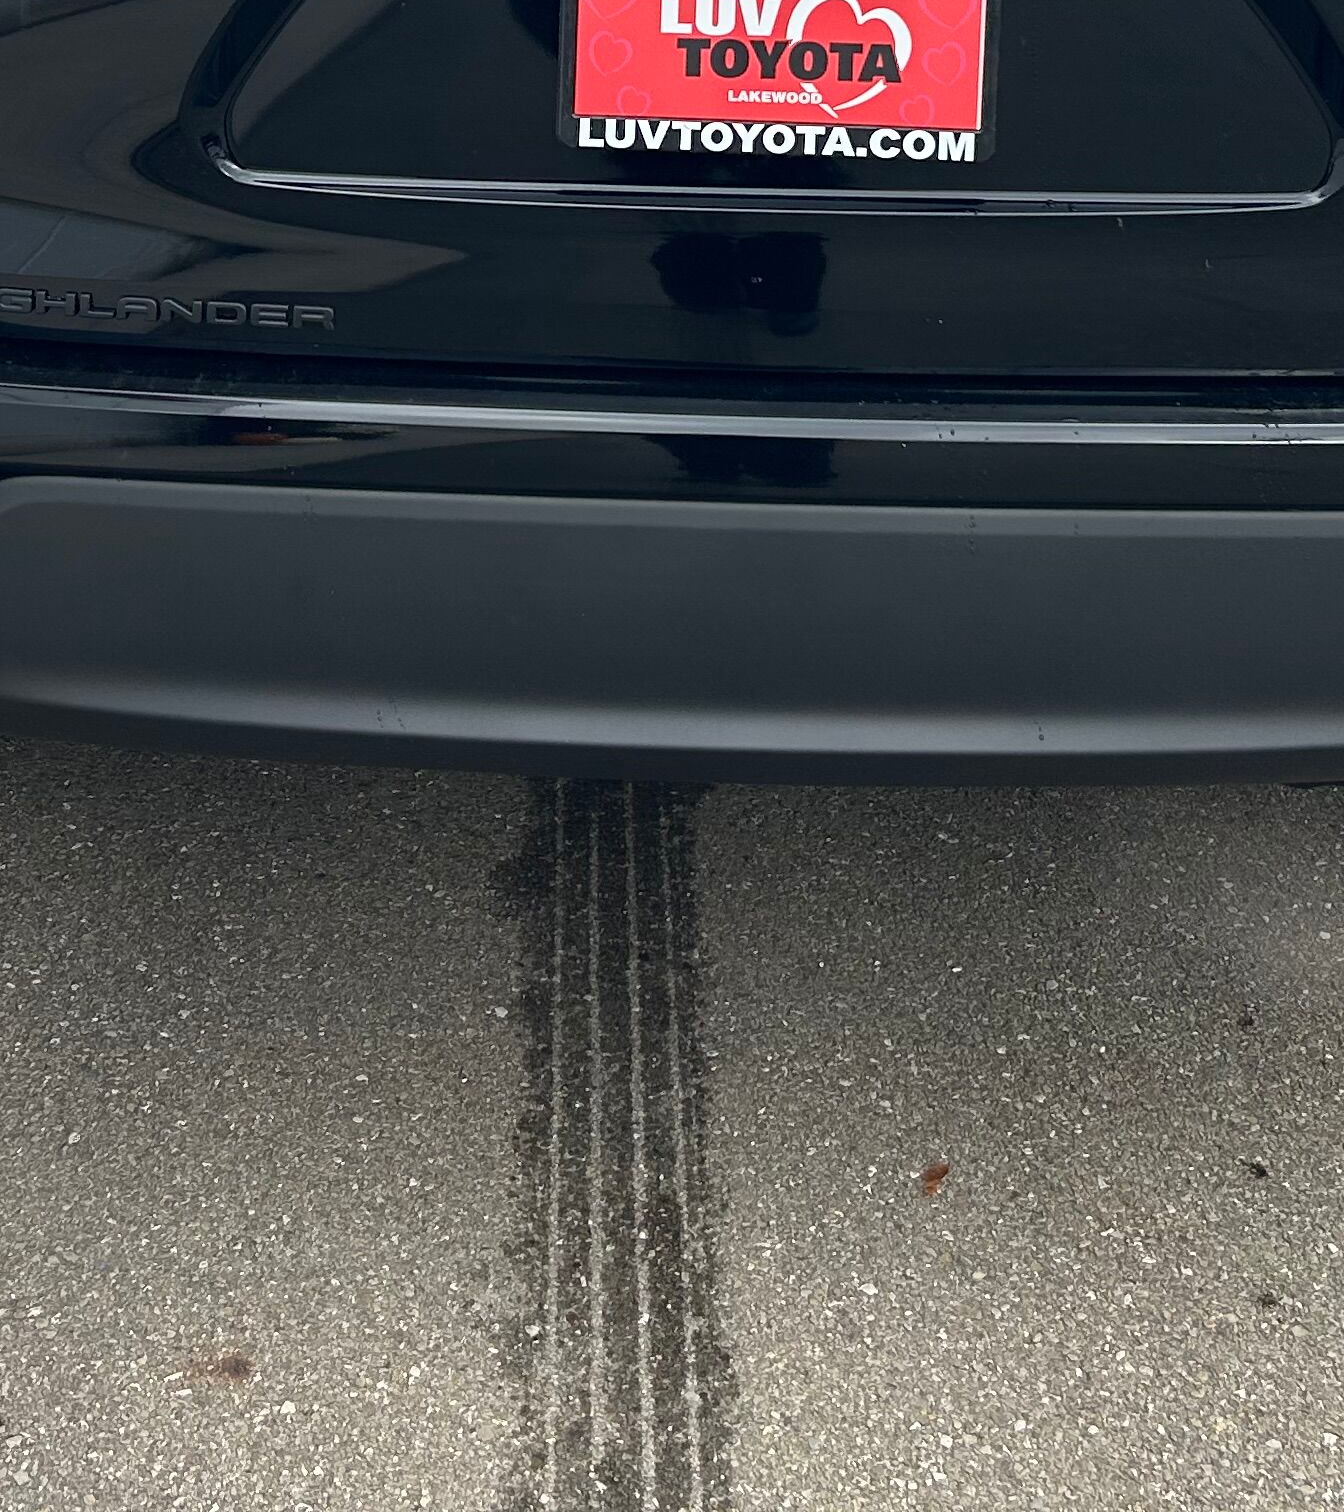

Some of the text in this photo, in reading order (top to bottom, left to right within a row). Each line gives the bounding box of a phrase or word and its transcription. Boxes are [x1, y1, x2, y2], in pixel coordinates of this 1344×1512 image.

[676, 38, 902, 84] TOYOTA
[727, 89, 824, 105] LAKEWOOD
[577, 116, 976, 163] LUVTOYOTA.COM
